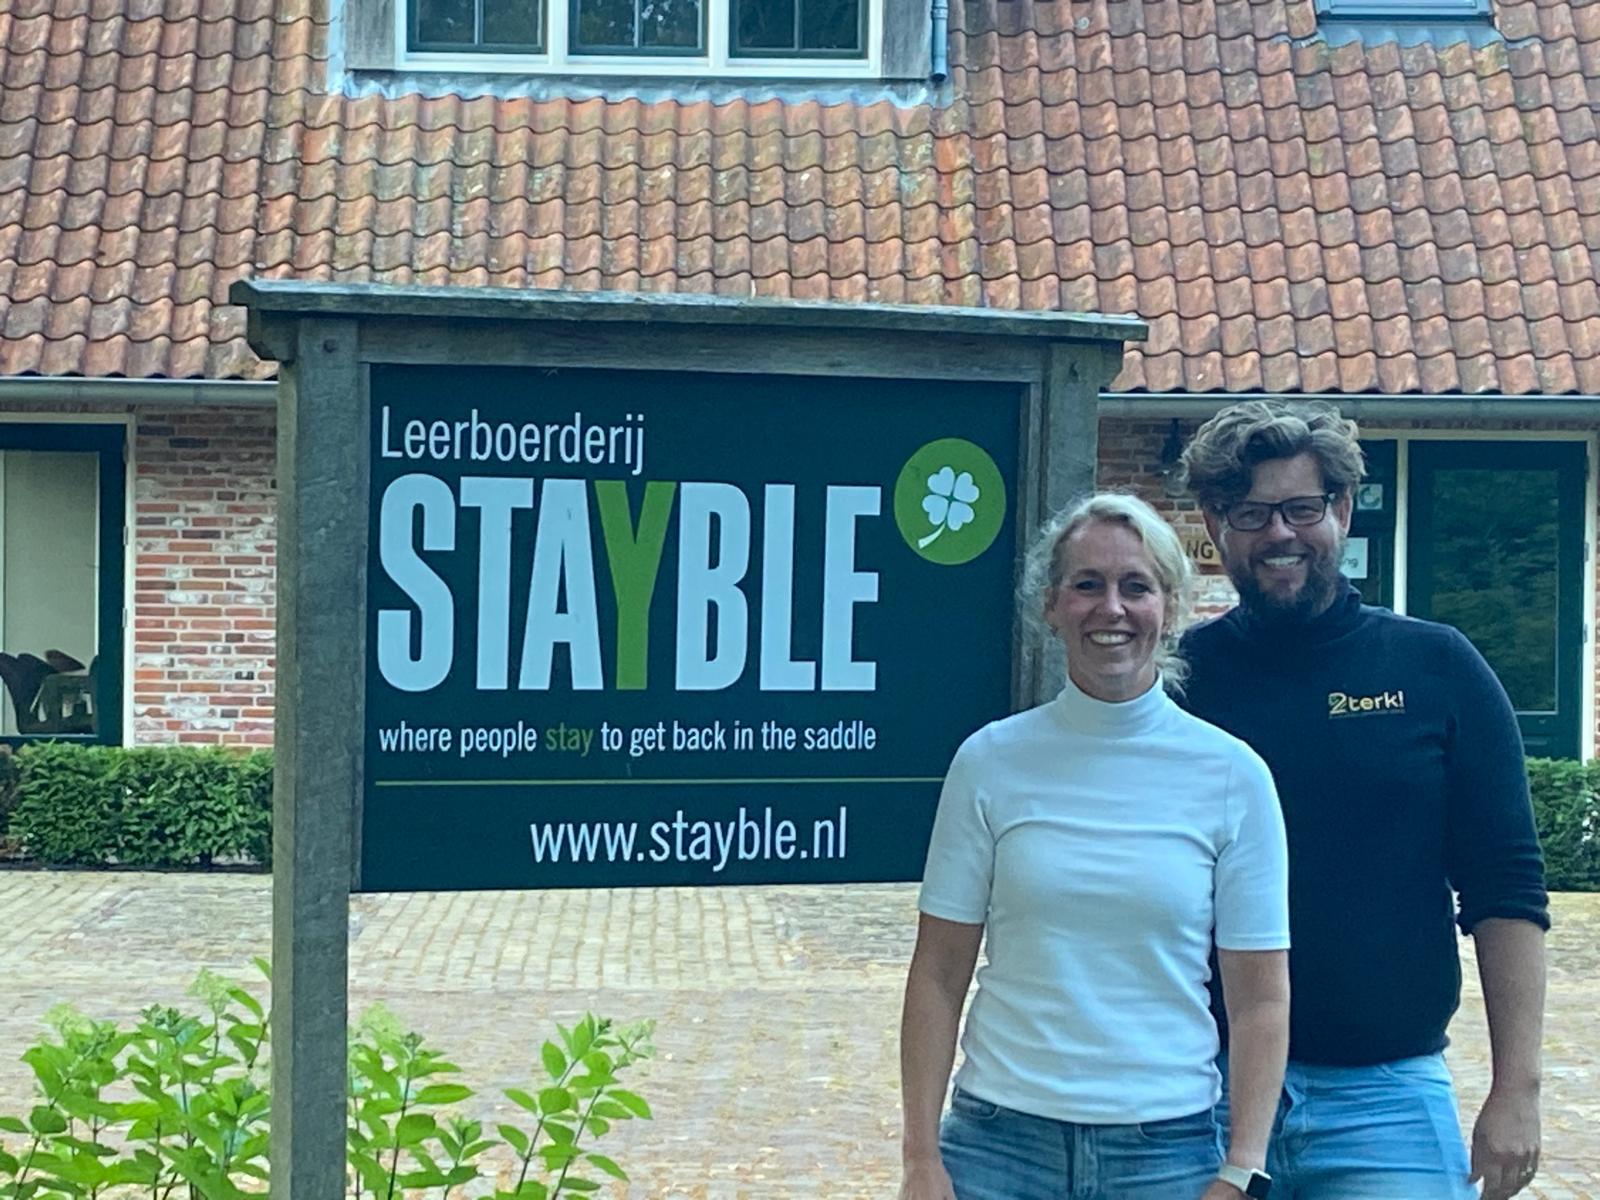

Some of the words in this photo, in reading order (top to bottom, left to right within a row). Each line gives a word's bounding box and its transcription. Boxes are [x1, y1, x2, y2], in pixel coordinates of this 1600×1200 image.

[381, 405, 645, 475] Leerboerderij
[377, 473, 882, 692] STAYBLE
[378, 721, 453, 753] where
[460, 720, 538, 758] people
[546, 724, 594, 757] stay
[601, 721, 624, 752] to
[629, 721, 667, 758] get
[673, 719, 727, 752] back
[734, 720, 755, 751] in
[761, 720, 797, 752] the
[804, 719, 877, 751] saddle
[530, 806, 848, 872] www.stayble.nl
